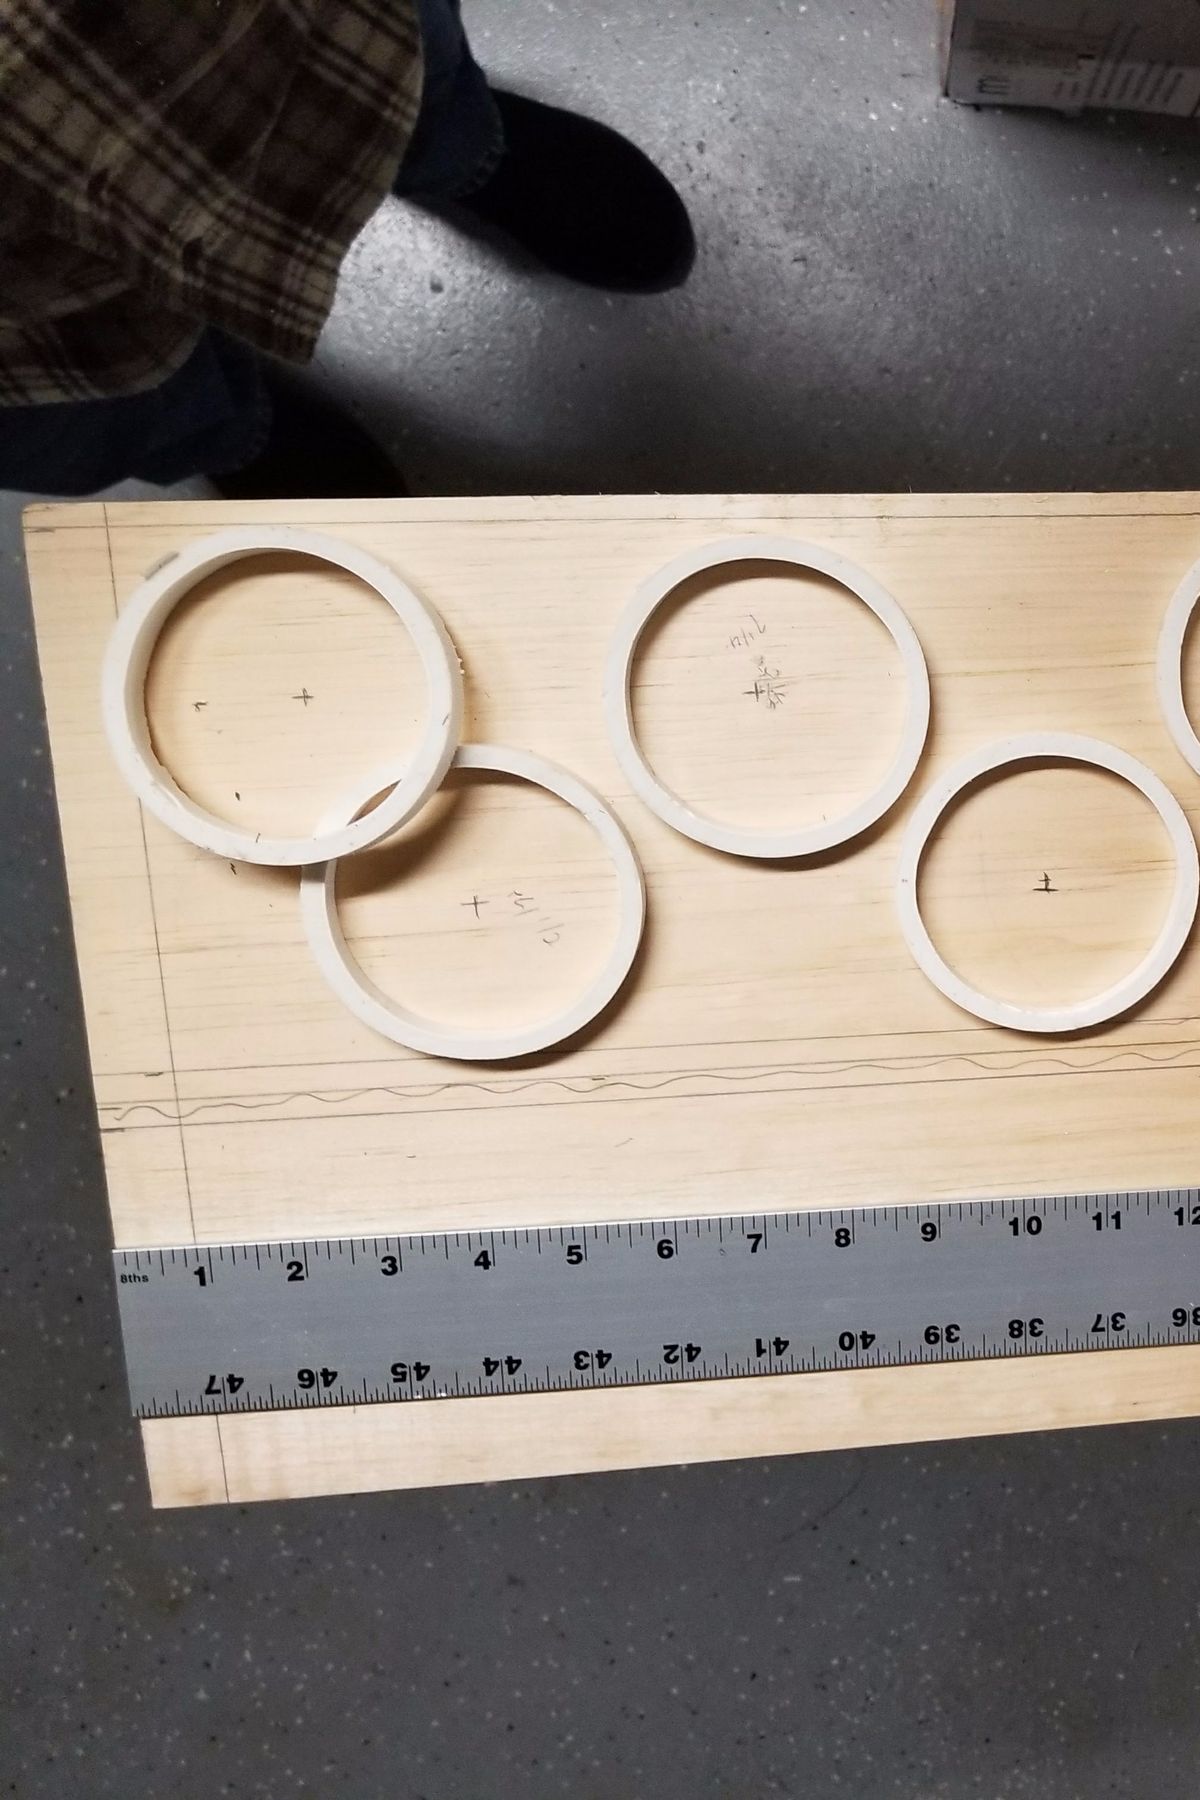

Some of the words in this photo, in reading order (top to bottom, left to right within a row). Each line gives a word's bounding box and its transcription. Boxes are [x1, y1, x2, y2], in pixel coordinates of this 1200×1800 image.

[120, 1272, 149, 1284] 8ths
[194, 1267, 206, 1286] 1
[287, 1261, 305, 1282] 2
[381, 1255, 398, 1276] 3
[474, 1250, 491, 1271] 4
[566, 1245, 583, 1265] 5
[656, 1239, 674, 1259] 6
[747, 1233, 763, 1253] 7
[834, 1227, 851, 1248] 8
[920, 1222, 937, 1242] 9
[1008, 1215, 1042, 1237] 10
[1092, 1210, 1123, 1231] 11
[1008, 1318, 1045, 1339] 38
[1090, 1311, 1126, 1333] 37
[838, 1330, 876, 1352] 40
[924, 1323, 961, 1345] 39
[663, 1343, 701, 1364] 42
[755, 1336, 790, 1358] 41
[482, 1355, 522, 1377] 44
[573, 1349, 613, 1371] 43
[297, 1367, 338, 1389] 46
[391, 1361, 431, 1383] 45
[204, 1373, 245, 1395] 47
